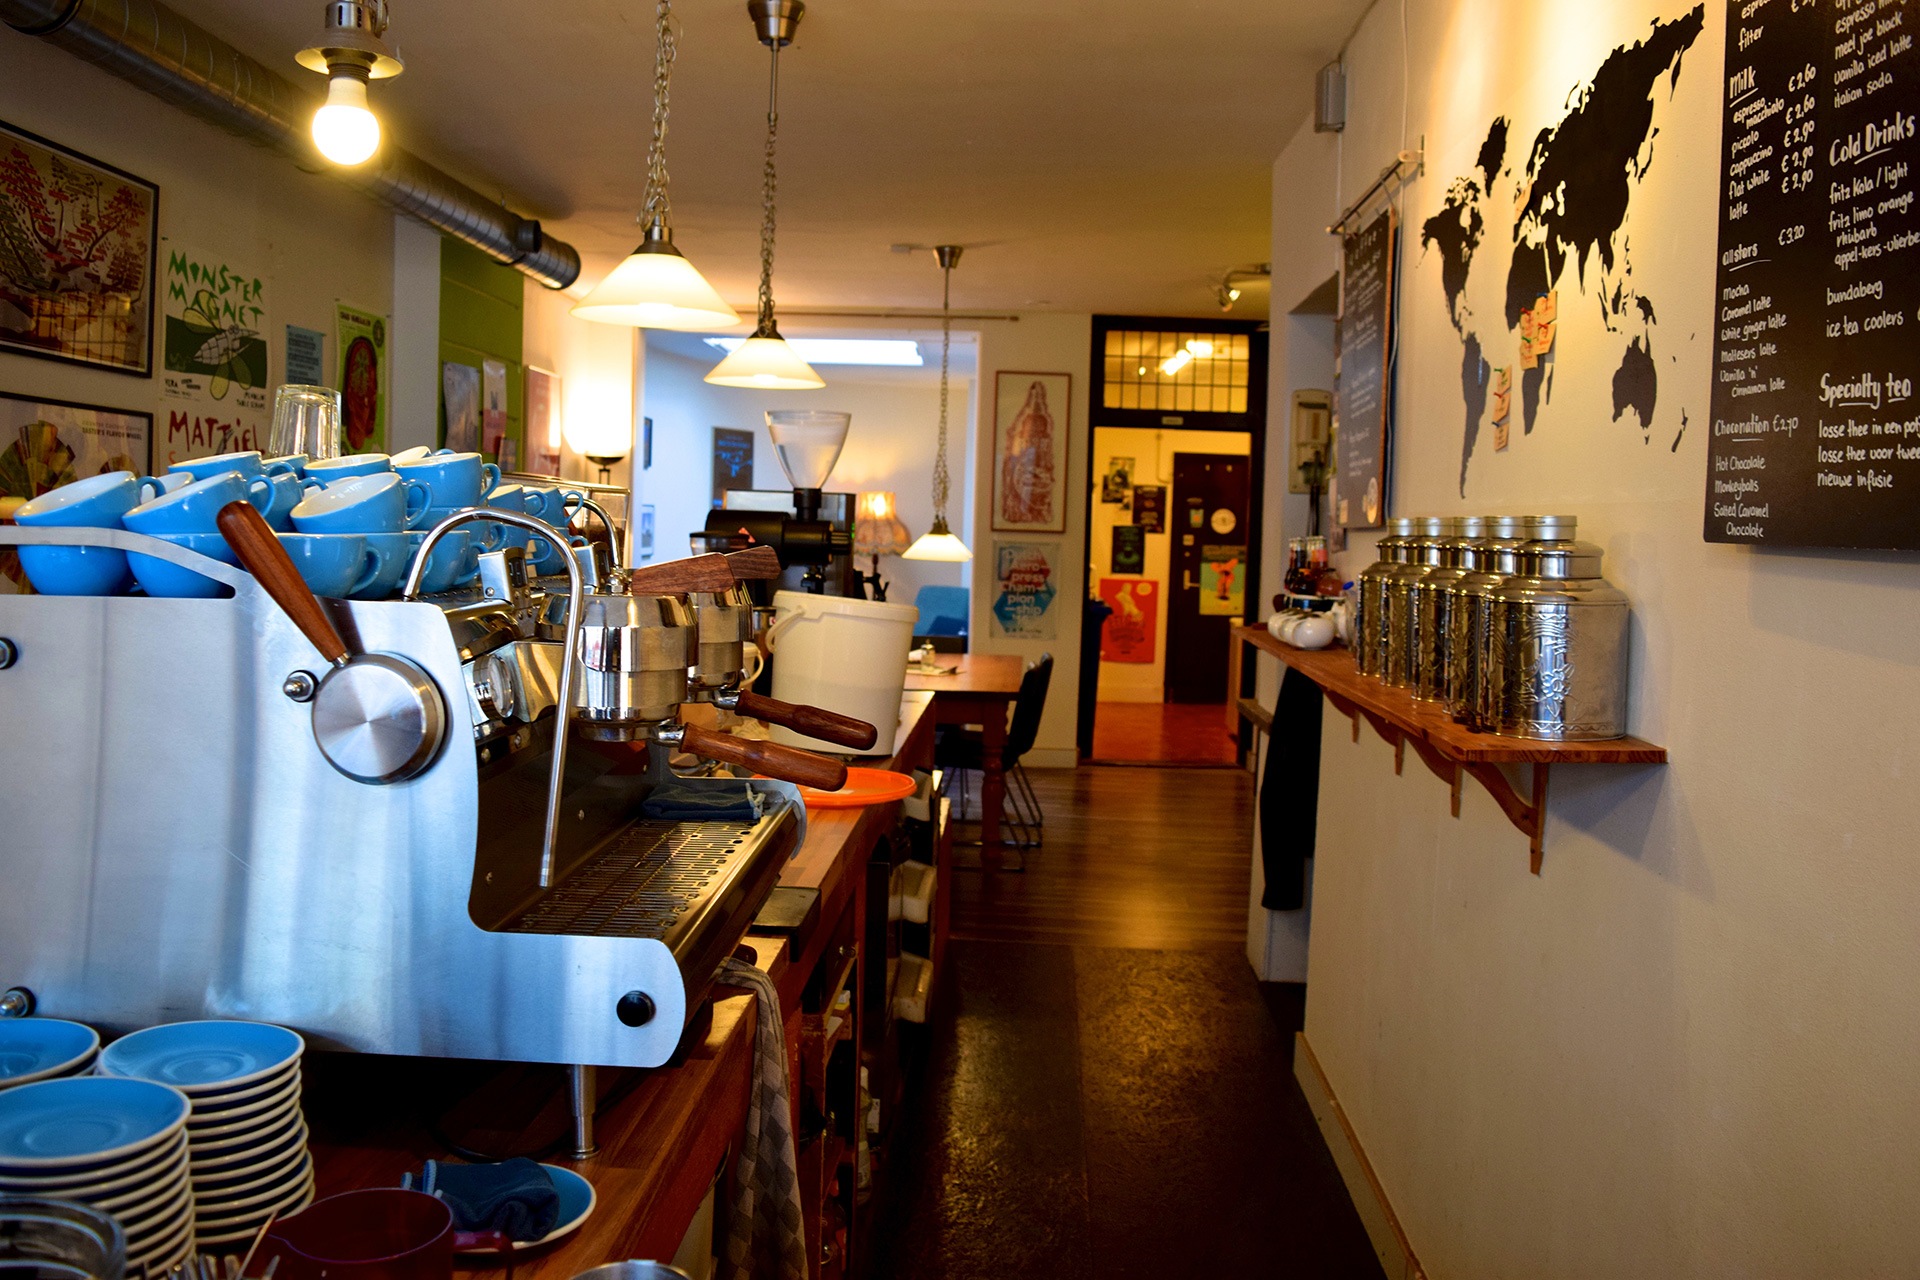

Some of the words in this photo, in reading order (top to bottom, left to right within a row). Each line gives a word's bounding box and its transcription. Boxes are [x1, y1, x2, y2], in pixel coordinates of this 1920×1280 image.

[1741, 0, 1771, 19] espre
[1835, 2, 1876, 34] espresso
[1738, 25, 1764, 51] filter
[1857, 28, 1873, 55] joe
[1876, 11, 1902, 37] black
[1867, 44, 1887, 69] iced
[1890, 34, 1912, 58] latte
[1834, 88, 1863, 109] italian
[1866, 72, 1893, 95] soda
[1733, 97, 1766, 124] espresso
[1746, 98, 1785, 130] macchiato
[1829, 132, 1861, 167] Cold
[1866, 111, 1916, 152] Drinks
[1729, 181, 1745, 200] flat
[1747, 170, 1770, 190] white
[1829, 181, 1851, 205] fritz
[1884, 161, 1909, 190] light
[1729, 201, 1748, 220] latte
[1828, 210, 1851, 232] fritz
[1852, 206, 1874, 225] limo
[1878, 191, 1914, 214] orange
[167, 249, 263, 305] MONSTER
[168, 280, 264, 328] MAGNET
[1753, 296, 1772, 312] latte
[1826, 280, 1883, 306] bundaberg
[1741, 320, 1767, 341] ginger
[1768, 313, 1788, 329] latte
[1826, 320, 1841, 338] ice
[1844, 315, 1859, 336] tea
[1864, 310, 1904, 332] coolers
[1759, 343, 1777, 357] latte
[1769, 377, 1786, 392] latte
[1819, 373, 1881, 410] Specialty
[1885, 372, 1912, 399] tea
[1819, 419, 1845, 438] losse
[1847, 418, 1869, 437] thee
[1872, 417, 1882, 435] in
[1884, 421, 1902, 434] een
[1716, 455, 1728, 472] Hot
[1729, 455, 1766, 471] Chocolate
[1818, 445, 1844, 463] losse
[1846, 445, 1866, 461] thee
[1870, 448, 1894, 460] voor
[1896, 443, 1920, 460] twee
[1817, 469, 1853, 487] nieuwe
[1857, 469, 1893, 492] infusie
[1714, 502, 1736, 517] Salted
[1726, 521, 1764, 538] Chocolate
